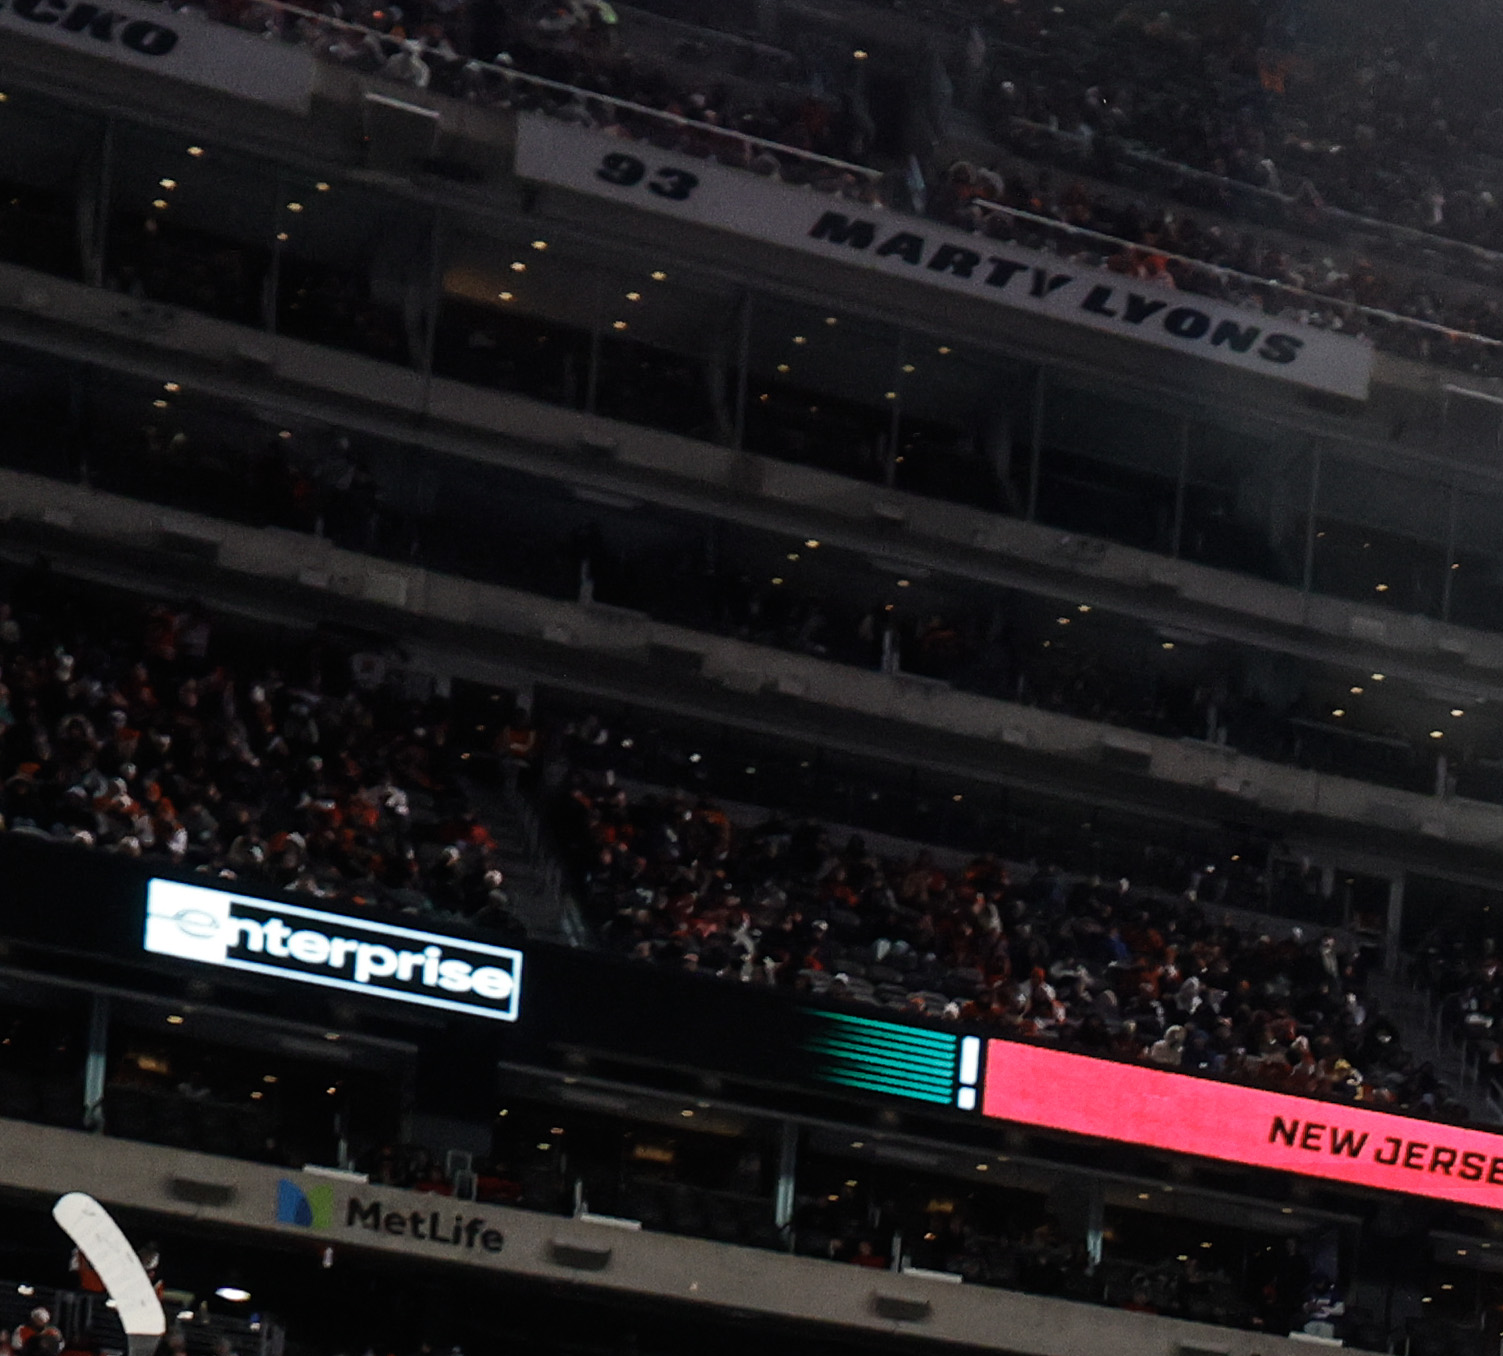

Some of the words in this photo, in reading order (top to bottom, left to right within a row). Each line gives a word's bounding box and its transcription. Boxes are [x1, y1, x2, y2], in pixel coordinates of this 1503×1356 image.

[594, 152, 701, 202] 93
[808, 208, 1068, 299] MARTY
[1080, 283, 1306, 366] LYONS
[172, 908, 514, 1000] enterprise
[1267, 1115, 1370, 1160] NEW
[346, 1196, 506, 1253] MetLife
